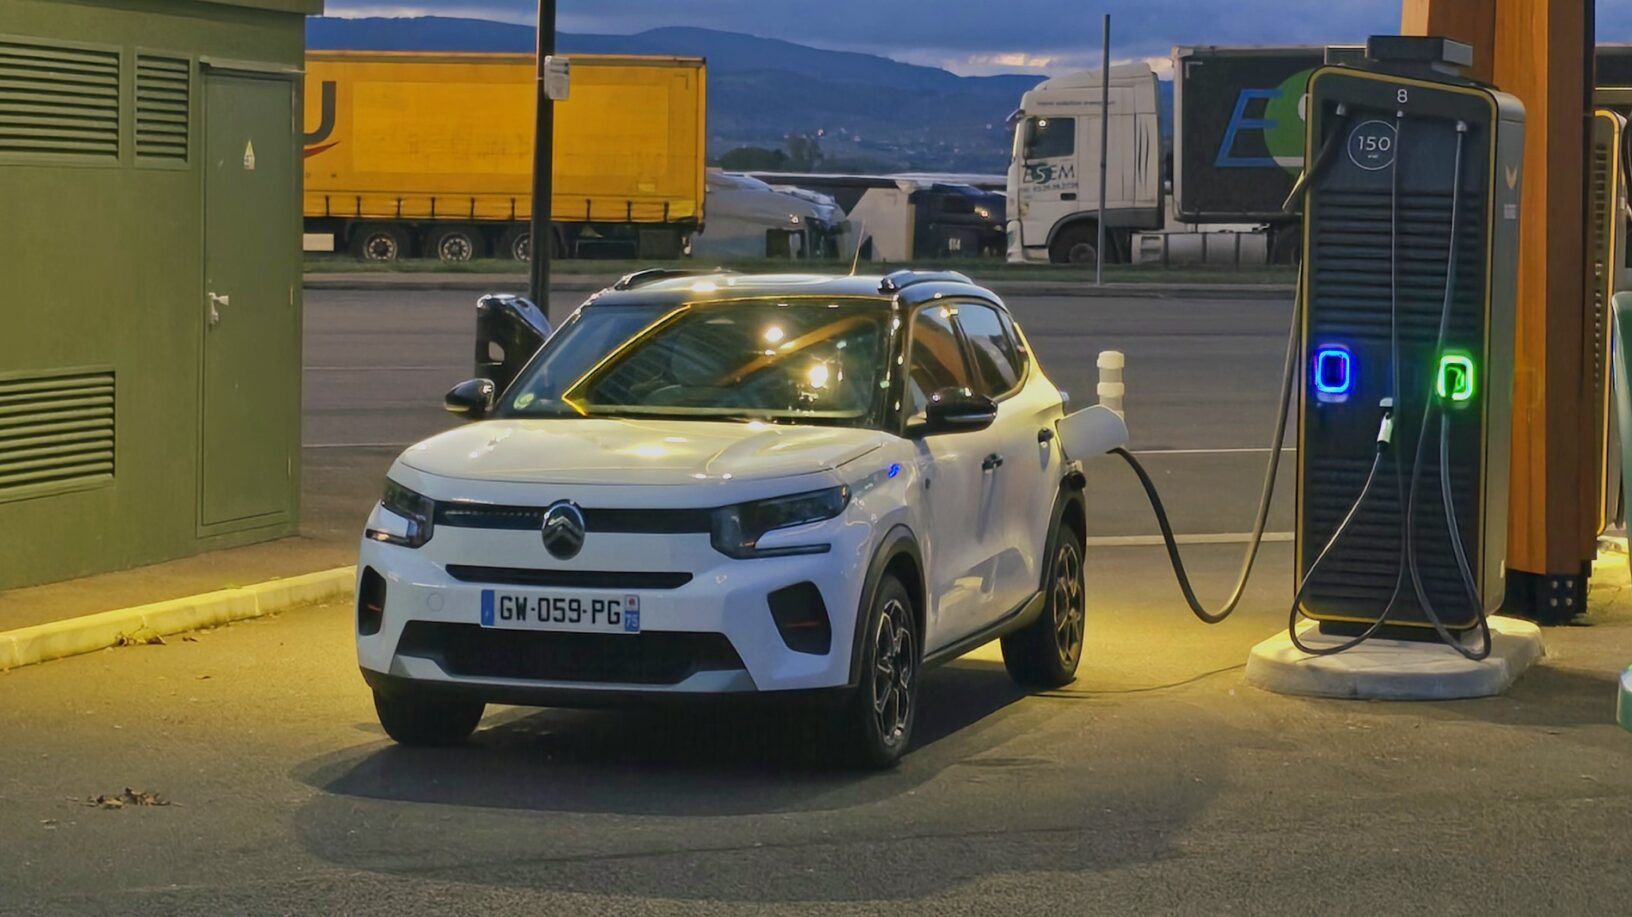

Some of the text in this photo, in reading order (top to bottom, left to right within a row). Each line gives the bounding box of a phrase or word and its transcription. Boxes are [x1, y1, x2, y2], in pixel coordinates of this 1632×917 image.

[1397, 89, 1408, 103] 8
[1358, 136, 1391, 151] 150
[500, 596, 621, 625] GW-059-PG
[625, 615, 639, 628] 75
